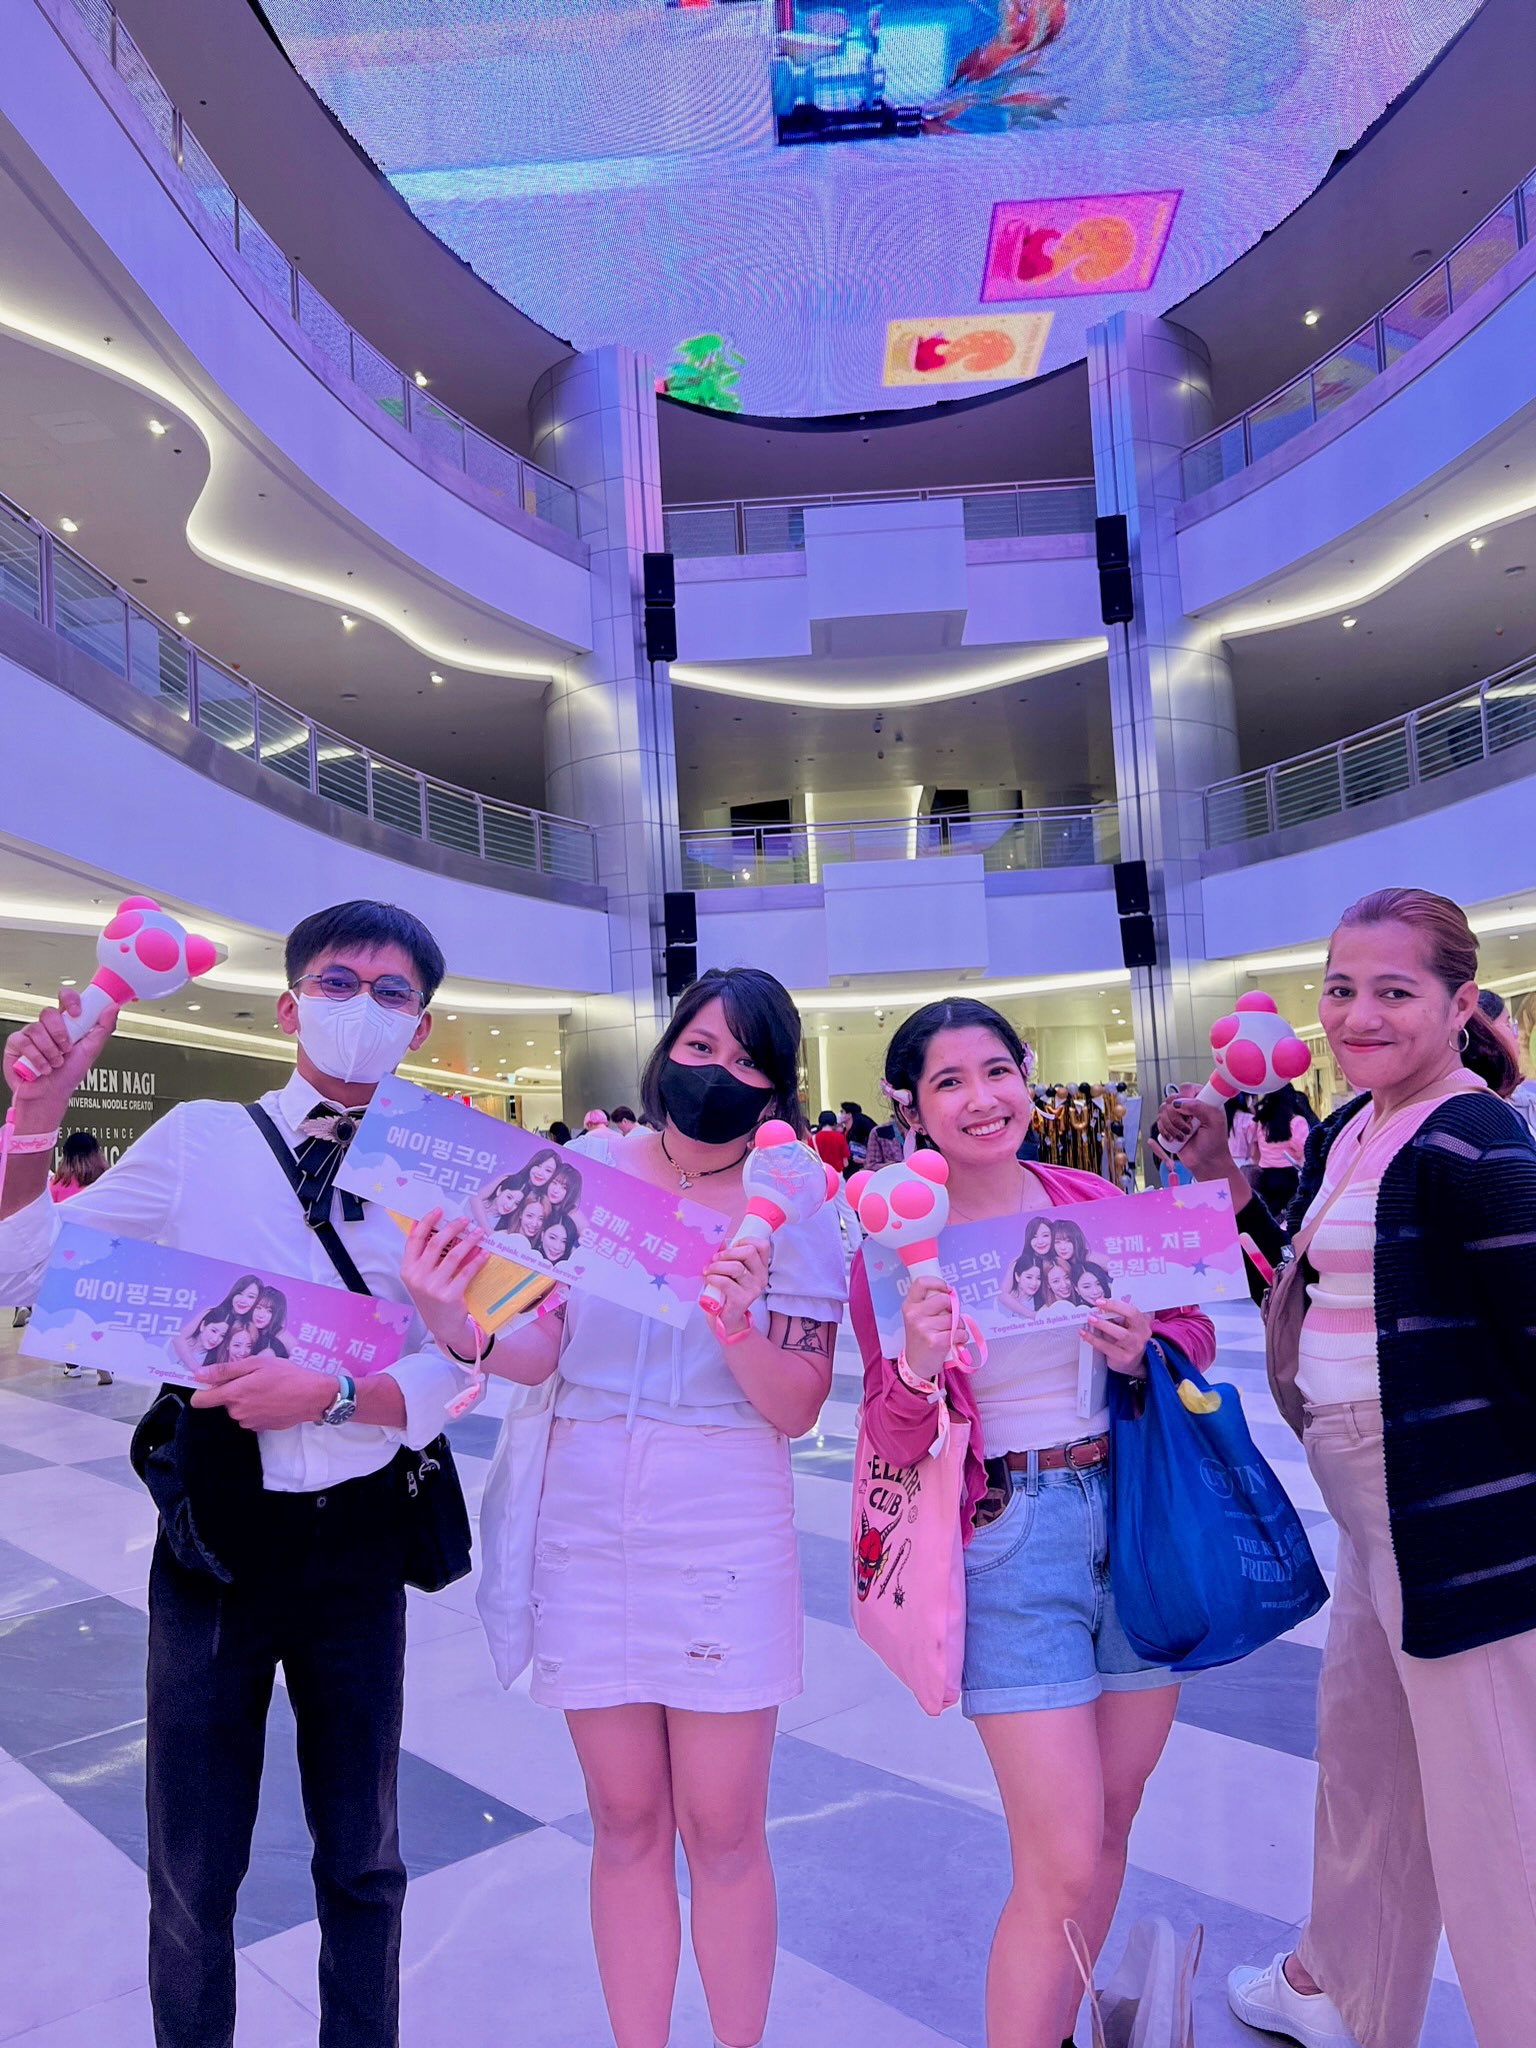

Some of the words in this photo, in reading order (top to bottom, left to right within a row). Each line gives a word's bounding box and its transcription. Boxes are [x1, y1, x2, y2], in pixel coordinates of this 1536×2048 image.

[75, 1068, 118, 1093] AMEN
[122, 1071, 155, 1095] NAGI
[69, 1097, 101, 1109] NIVERSAL
[102, 1098, 128, 1110] NOODLE
[386, 1125, 497, 1174] 에이핑크와
[412, 1162, 482, 1196] 그리고
[578, 1227, 636, 1269] 영원히
[589, 1205, 632, 1242] 함께,
[639, 1231, 679, 1263] 지금
[1103, 1234, 1152, 1255] 함께,
[1160, 1230, 1201, 1249] 지금
[1107, 1255, 1166, 1278] 영원히
[75, 1277, 198, 1311] 에이핑크와
[959, 1277, 1002, 1304] 리고
[108, 1311, 183, 1336] 그리고
[298, 1322, 338, 1353] 함께,
[345, 1339, 377, 1363] 지금
[289, 1346, 343, 1376] 영원히
[869, 1487, 902, 1517] CLUB
[1233, 1535, 1260, 1555] THE
